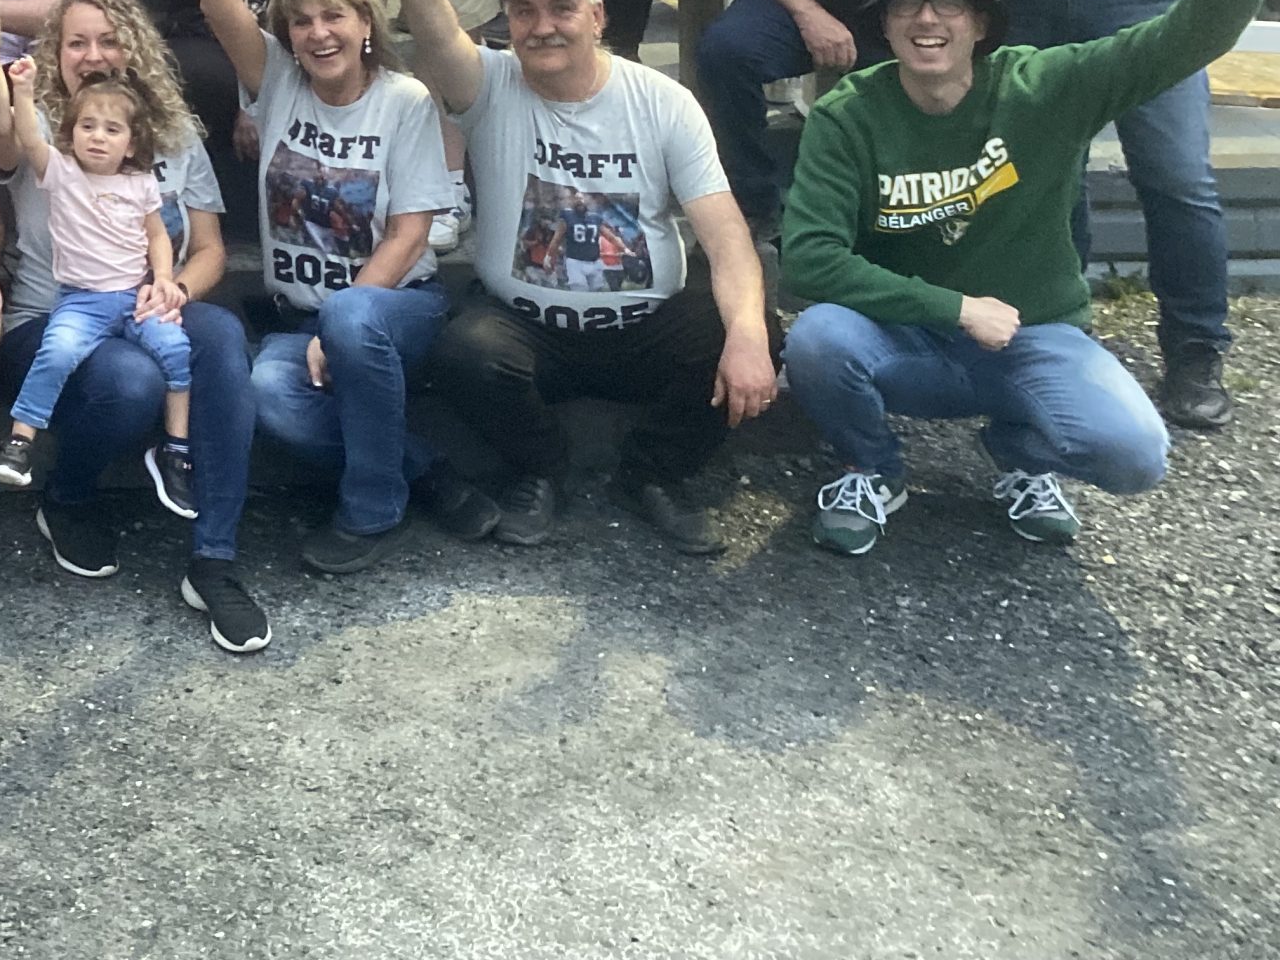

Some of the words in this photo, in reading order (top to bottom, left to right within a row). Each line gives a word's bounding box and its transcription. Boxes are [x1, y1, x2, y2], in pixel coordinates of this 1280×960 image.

[878, 137, 1008, 206] PATRIOTES
[878, 202, 970, 229] BÉLANGER
[573, 224, 598, 243] 67
